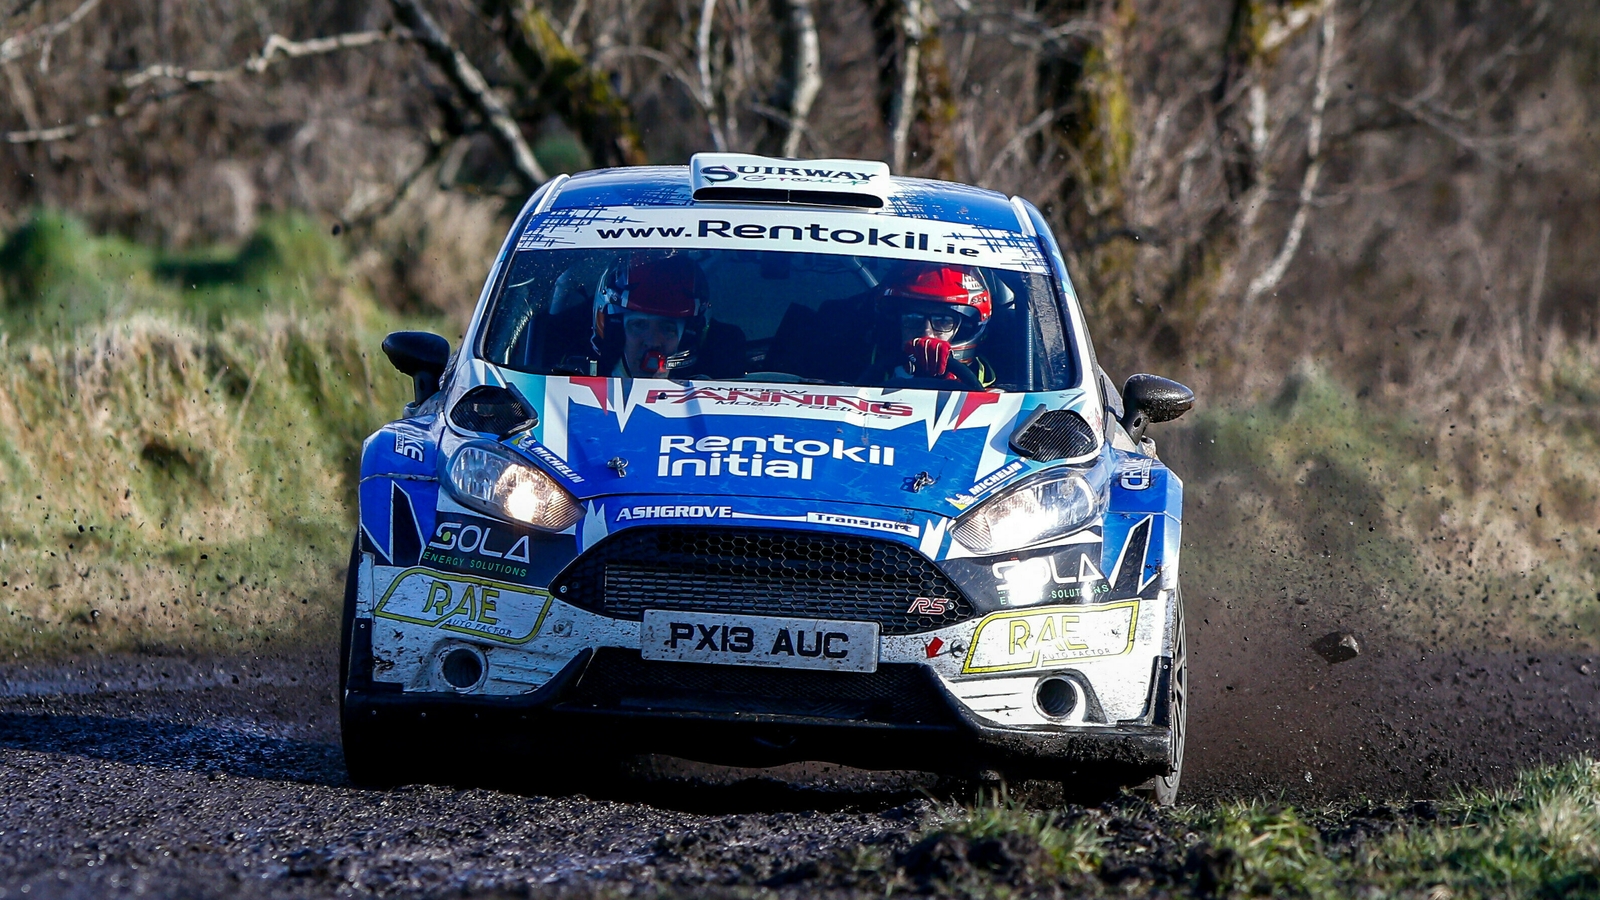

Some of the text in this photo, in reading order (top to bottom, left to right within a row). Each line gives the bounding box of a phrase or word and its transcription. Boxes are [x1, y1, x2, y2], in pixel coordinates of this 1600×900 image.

[700, 164, 878, 186] SUIRWAY
[596, 219, 980, 258] www.Rentokil.ie
[645, 386, 914, 417] FANNING
[700, 386, 808, 395] ANDREW
[659, 434, 895, 466] Rentokil
[531, 446, 585, 484] MICHELIN
[657, 452, 814, 480] Initial
[968, 461, 1023, 496] MICHELIN
[615, 505, 913, 533] ASHGROVE Transport
[429, 522, 531, 564] SOLA
[422, 551, 528, 577] ENERGY SOLUTIONS
[421, 579, 500, 626] RAE
[907, 597, 950, 615] RS
[1051, 584, 1110, 600] SOLUTNS
[446, 618, 513, 637] AUTO FACTOR
[670, 621, 849, 659] PX13 AUC
[1008, 615, 1090, 656] RAE
[1042, 647, 1111, 661] AUTO FACTOR
